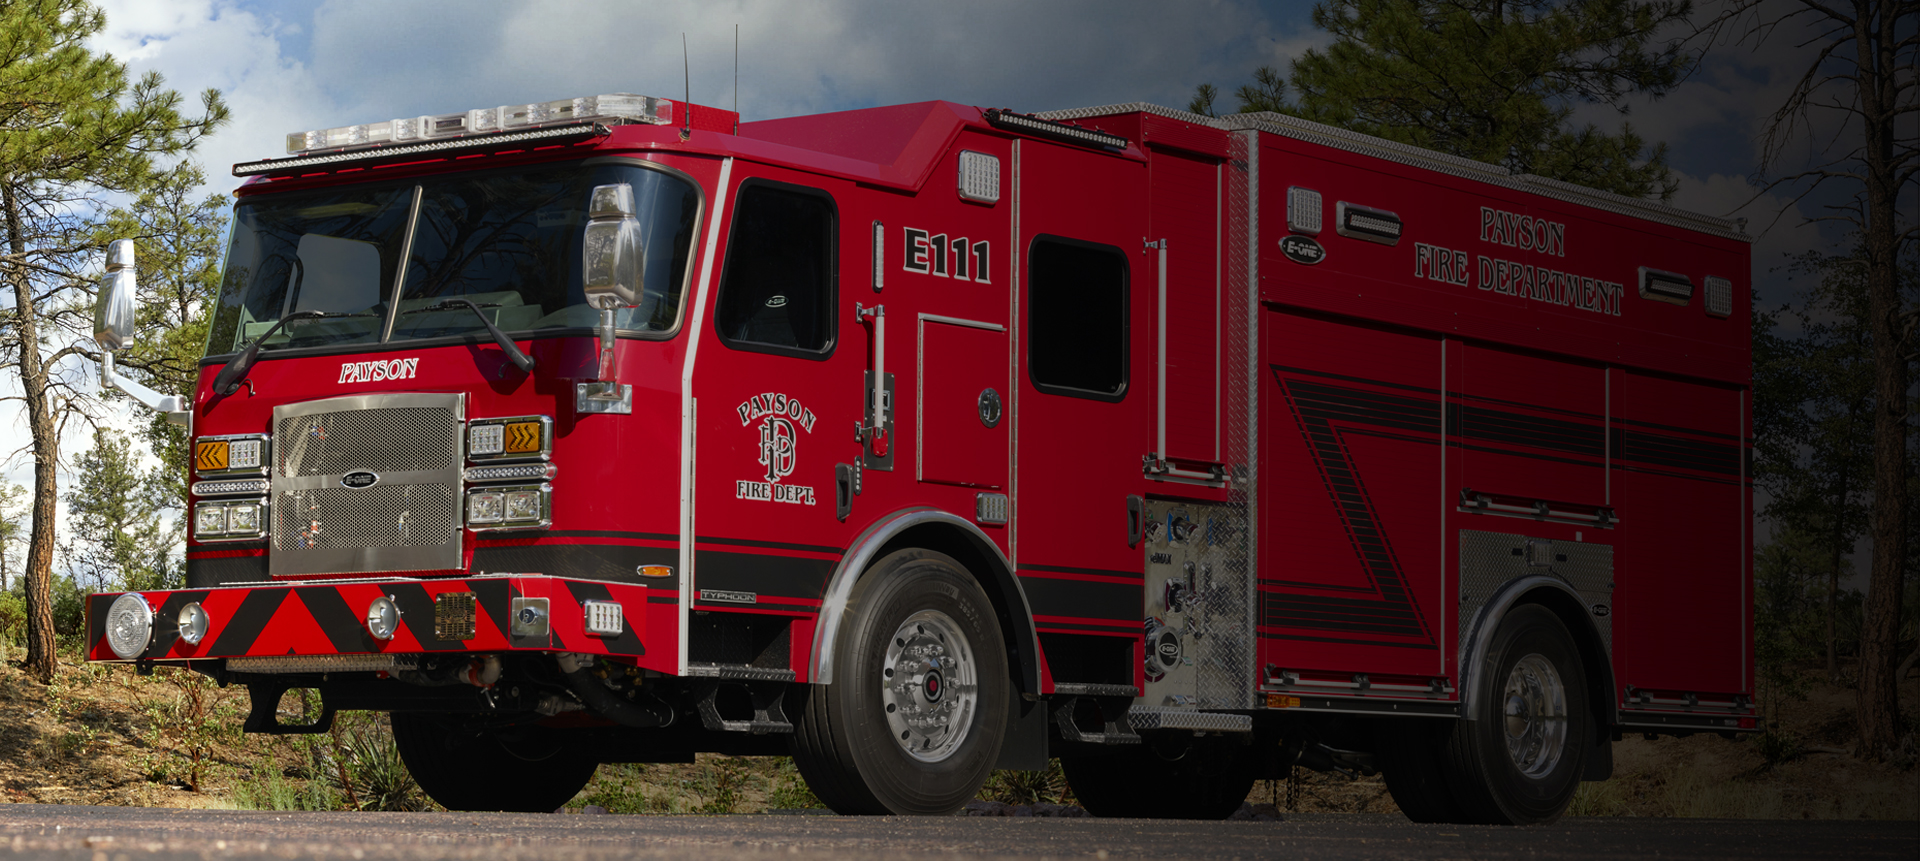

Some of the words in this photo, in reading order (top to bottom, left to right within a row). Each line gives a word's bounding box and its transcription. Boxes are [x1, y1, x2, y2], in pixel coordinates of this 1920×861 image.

[1480, 206, 1565, 257] PAYSON
[902, 226, 992, 285] E111
[1287, 240, 1318, 258] E-ONE
[1414, 242, 1469, 288] FIRE
[1477, 255, 1625, 317] DEPARTMENT
[337, 357, 420, 384] PAYSON
[736, 391, 817, 434] PAYSON
[345, 474, 372, 484] E-ONE
[736, 480, 772, 502] FIRE
[773, 483, 817, 506] DEPT.
[702, 591, 755, 601] TYPHOON
